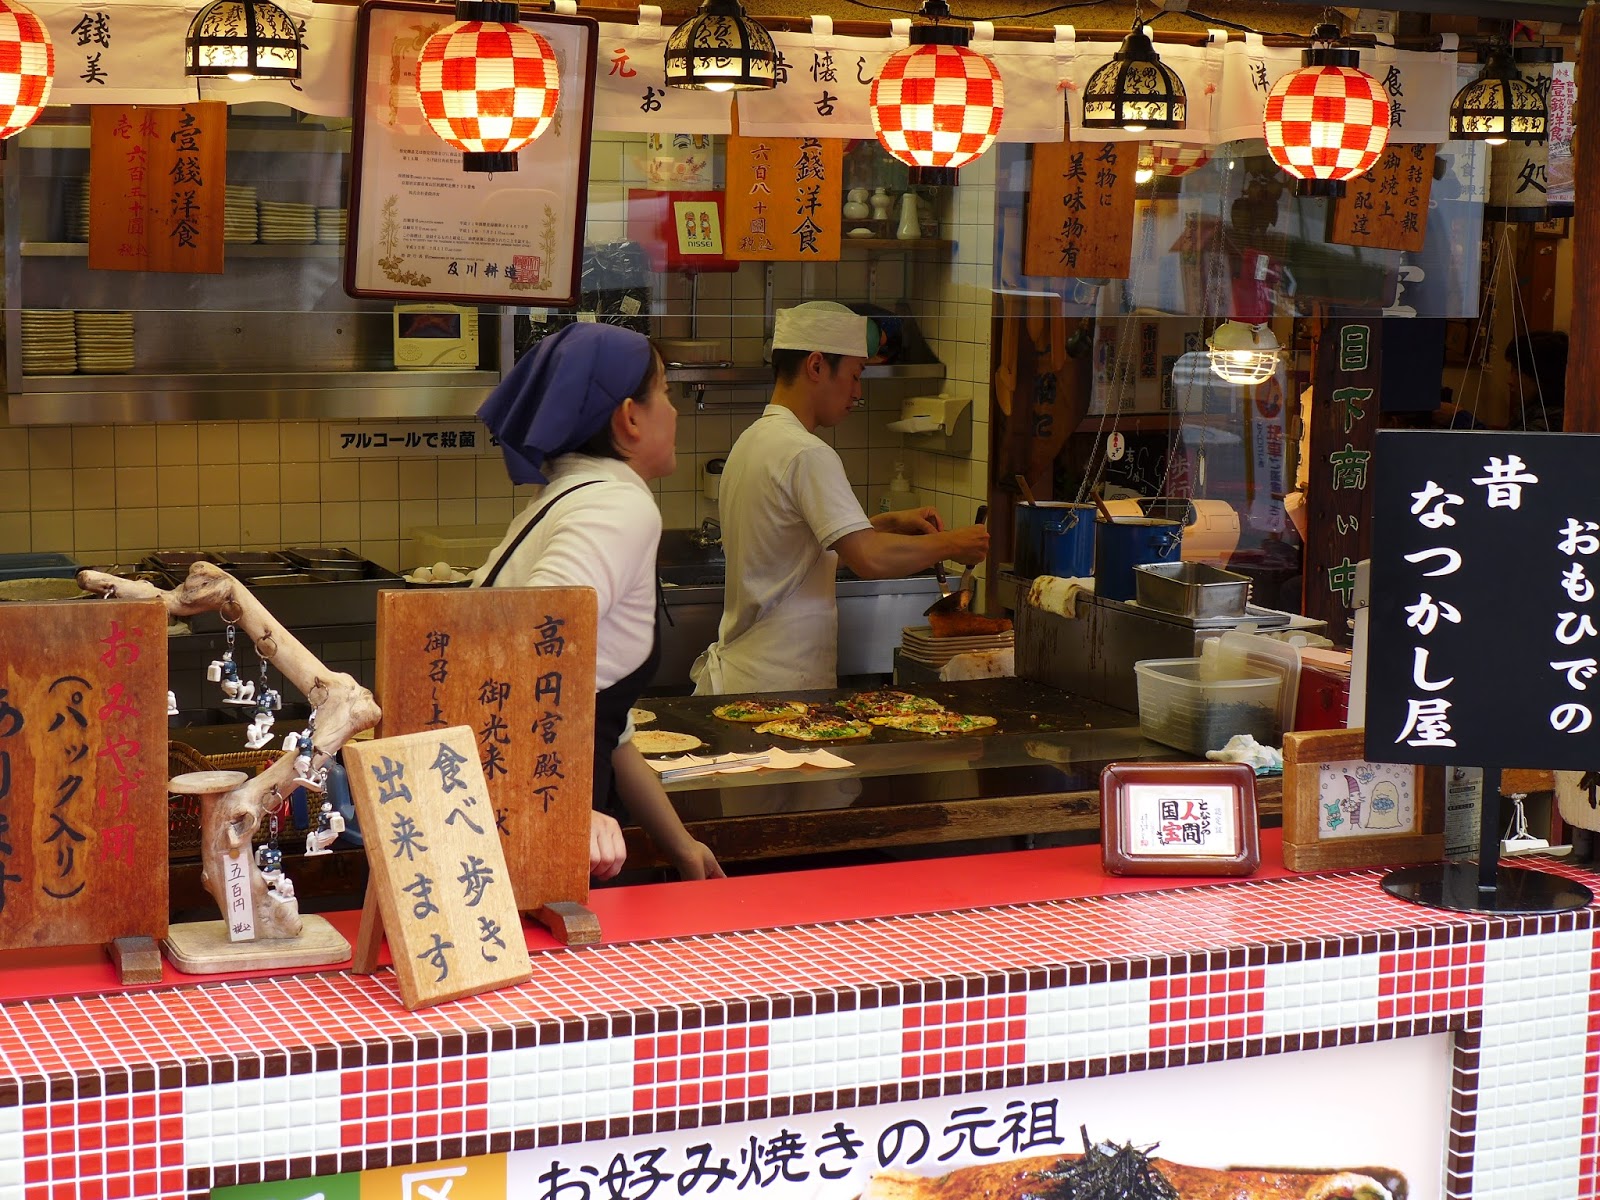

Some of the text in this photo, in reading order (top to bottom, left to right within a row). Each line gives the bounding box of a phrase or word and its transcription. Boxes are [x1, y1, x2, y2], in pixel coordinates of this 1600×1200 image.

[80, 51, 108, 85] 美
[608, 47, 637, 78] 元
[1248, 60, 1404, 97] 洋 食
[640, 86, 665, 113] お
[813, 90, 839, 117] 古
[1094, 142, 1118, 207] 名物に
[1060, 151, 1089, 269] 美味物有
[688, 240, 713, 248] NISSEI
[340, 431, 476, 449] アルコールで殺菌
[1328, 324, 1374, 608] 目下商い中
[1471, 454, 1539, 510] 昔
[1394, 480, 1465, 748] なつかし屋
[1549, 517, 1600, 734] おもひでの
[98, 620, 144, 868] おみやげ用
[531, 614, 565, 815] 高円宮殿下
[370, 754, 455, 983] 出来ます
[428, 741, 507, 964] 食べ歩き
[227, 862, 246, 912] 五百円
[538, 1098, 1066, 1200] お好み焼きの元祖
